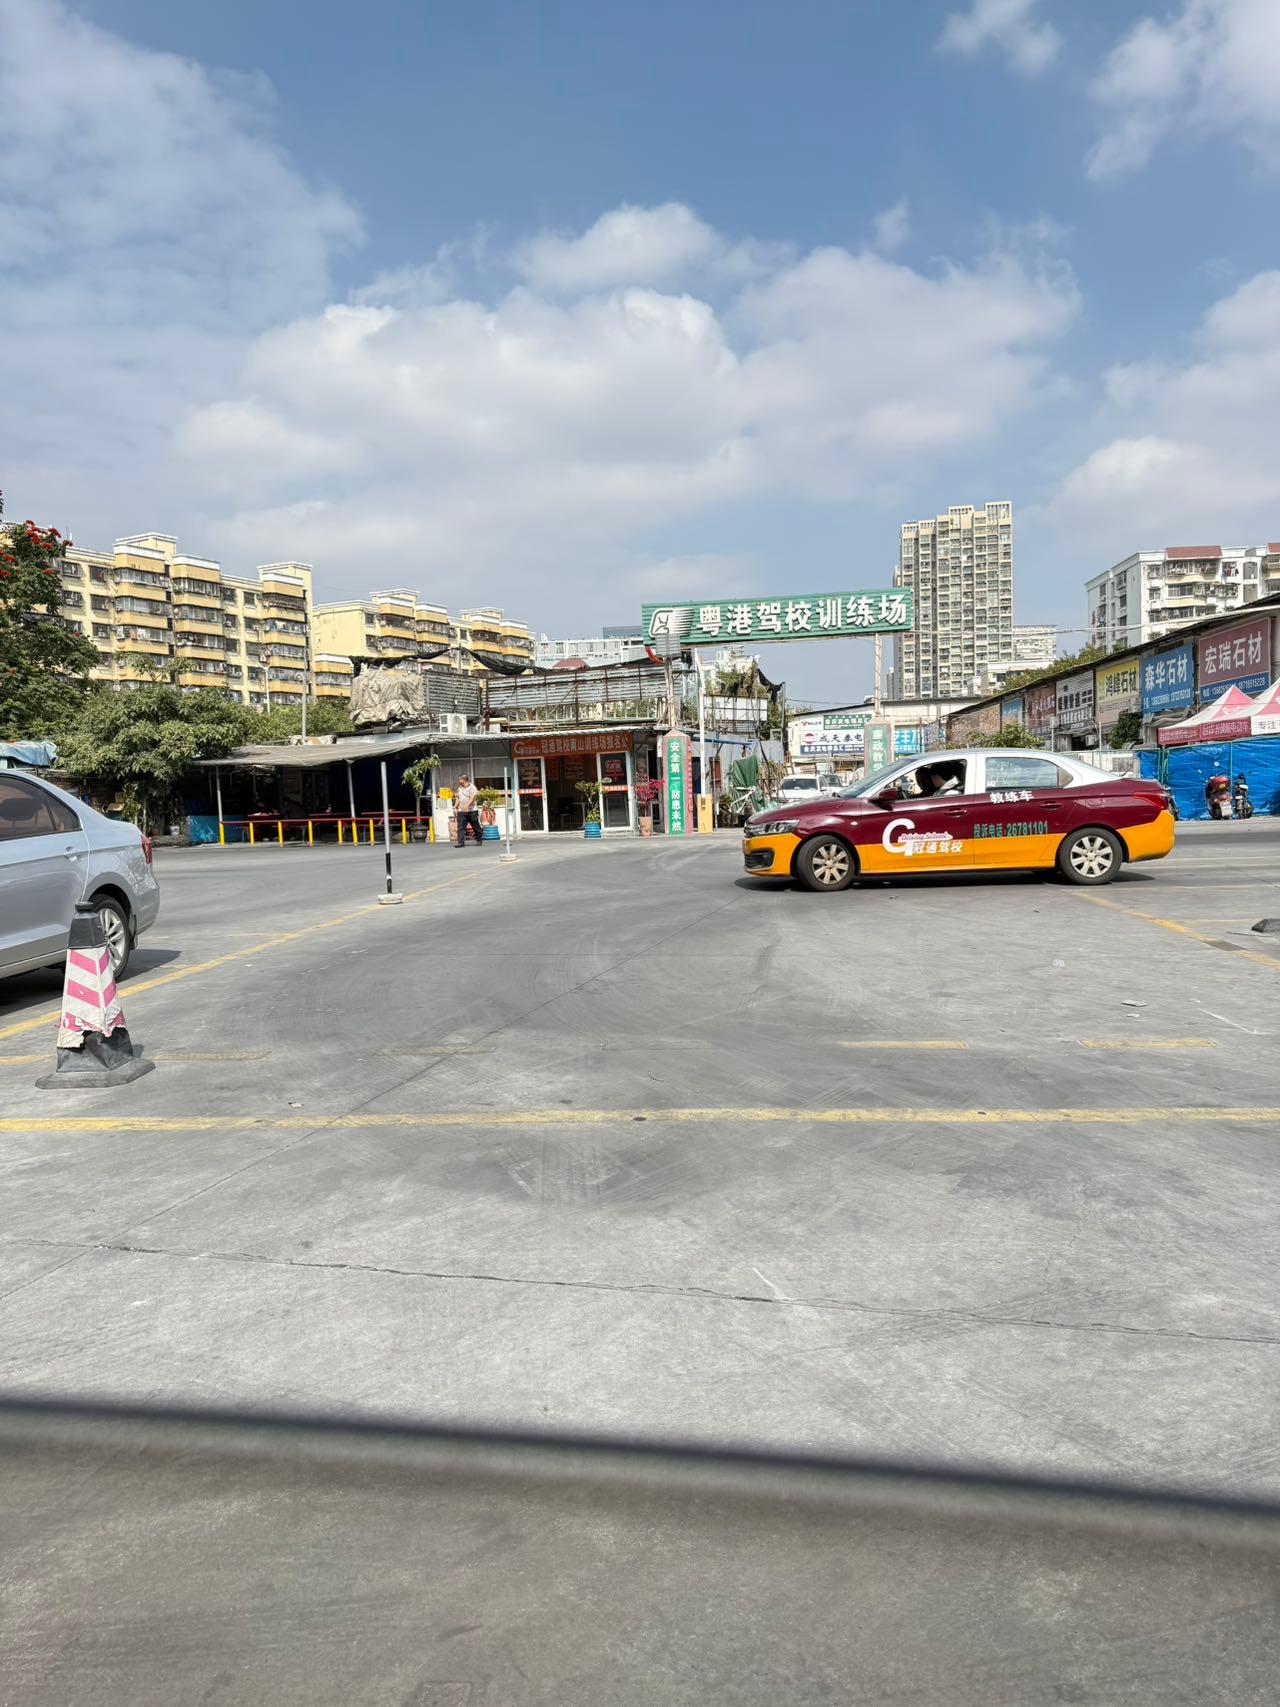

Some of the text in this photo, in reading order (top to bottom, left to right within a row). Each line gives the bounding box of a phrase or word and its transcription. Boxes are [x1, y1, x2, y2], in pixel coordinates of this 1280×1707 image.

[697, 594, 906, 636] 粤港驾校训练场
[1204, 631, 1263, 675] 宏瑞石材
[1144, 653, 1187, 692] 森华石材
[1258, 721, 1280, 730] 专注
[990, 790, 1034, 804] 教练车
[913, 841, 963, 854] 冠通驾校
